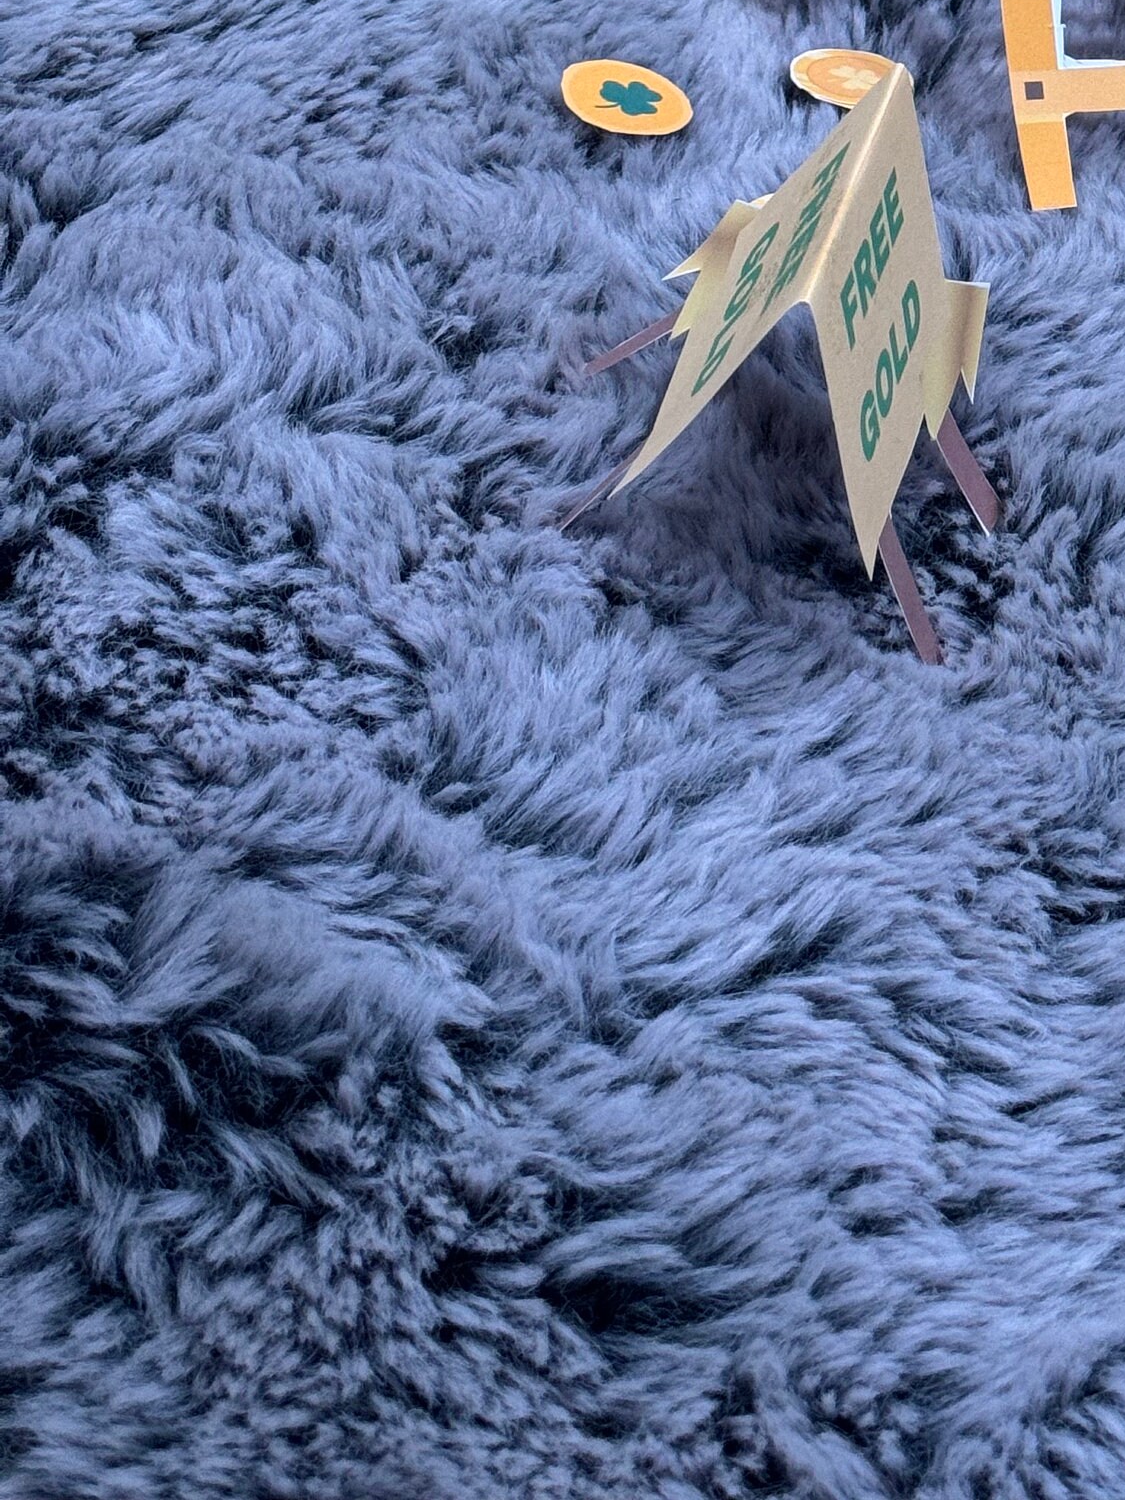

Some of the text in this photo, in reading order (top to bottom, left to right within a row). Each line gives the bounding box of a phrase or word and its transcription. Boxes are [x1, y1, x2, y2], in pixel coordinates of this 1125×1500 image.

[690, 221, 779, 396] GOLD
[839, 165, 905, 351] FREE
[860, 279, 921, 462] GOLD
